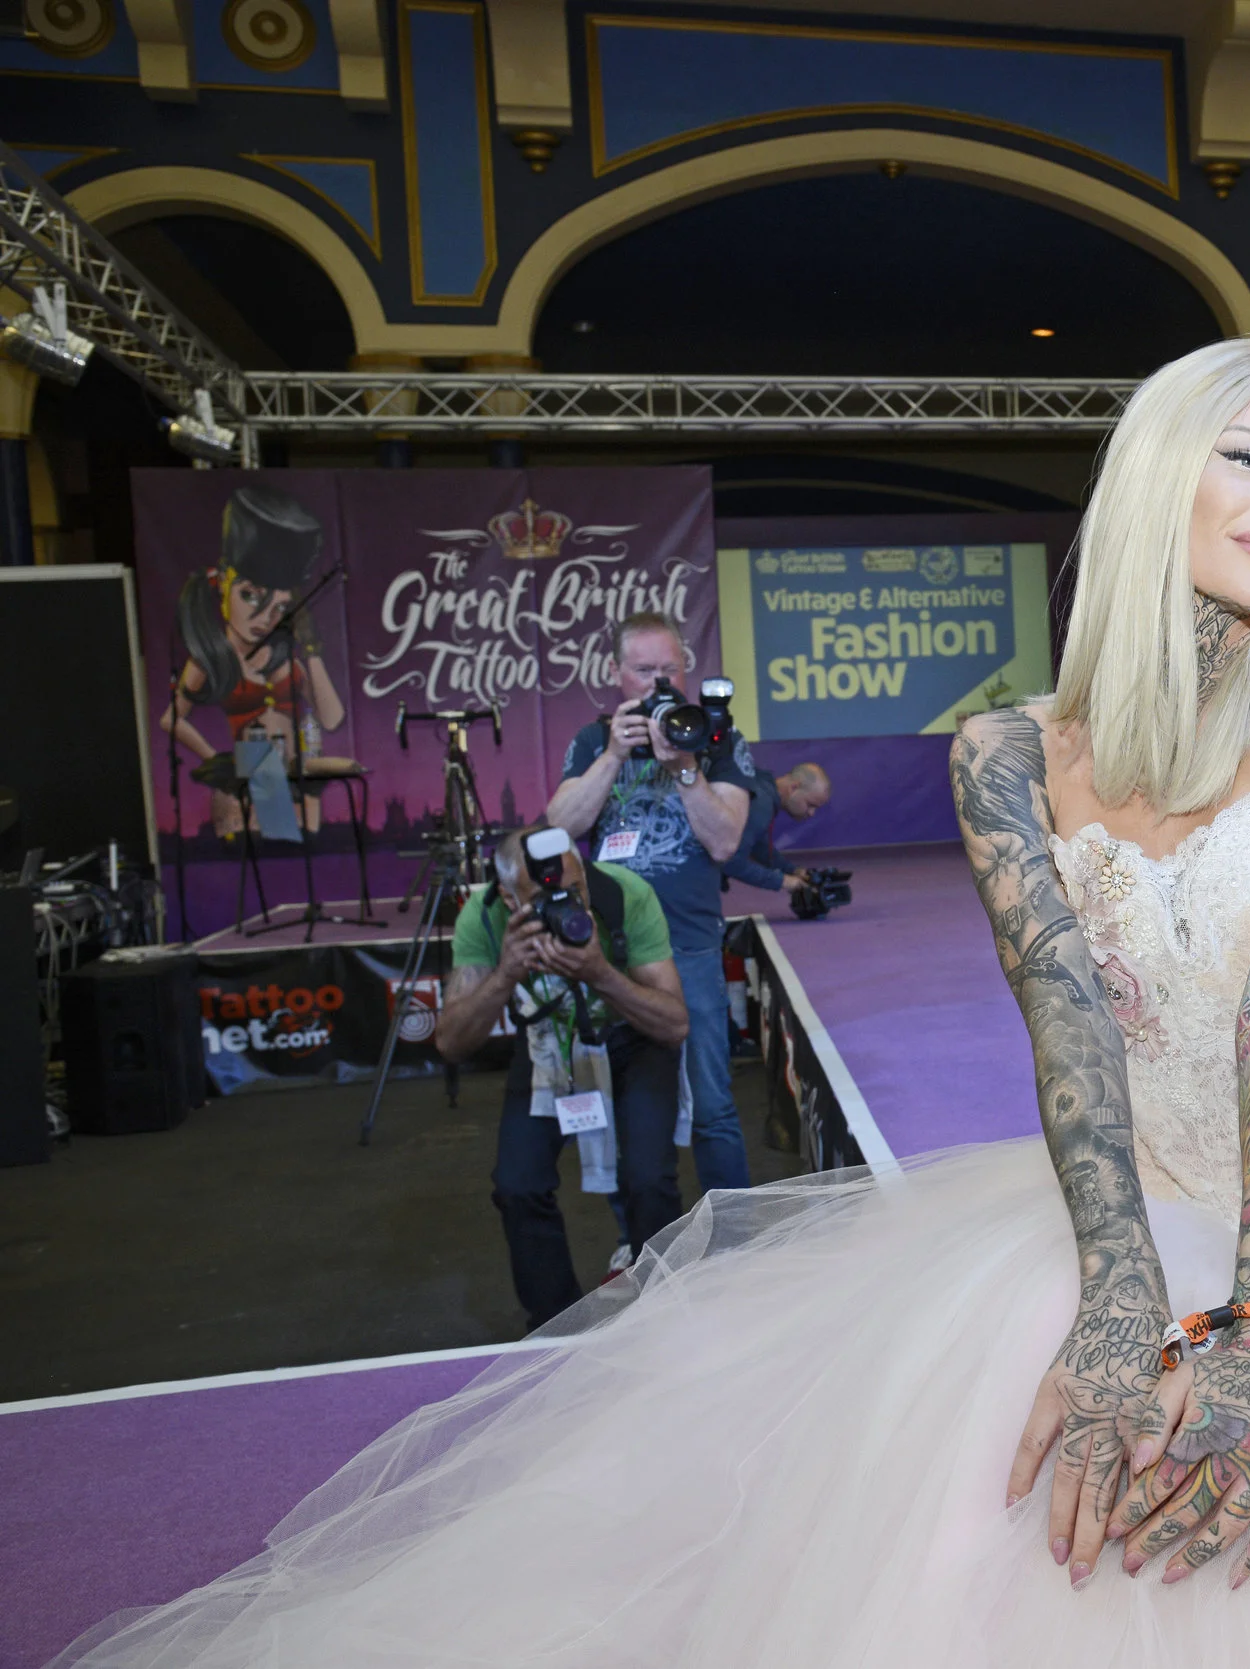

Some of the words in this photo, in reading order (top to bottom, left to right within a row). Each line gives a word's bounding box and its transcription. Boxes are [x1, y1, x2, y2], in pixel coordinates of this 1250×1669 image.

[425, 549, 471, 585] The
[368, 567, 536, 656] Great
[530, 548, 702, 638] British
[763, 588, 856, 615] Vintage
[877, 584, 1005, 610] Alternative
[811, 610, 997, 660] Fashion
[383, 638, 540, 706] Tattoo
[768, 654, 907, 702] Show
[199, 983, 344, 1020] Tattoo
